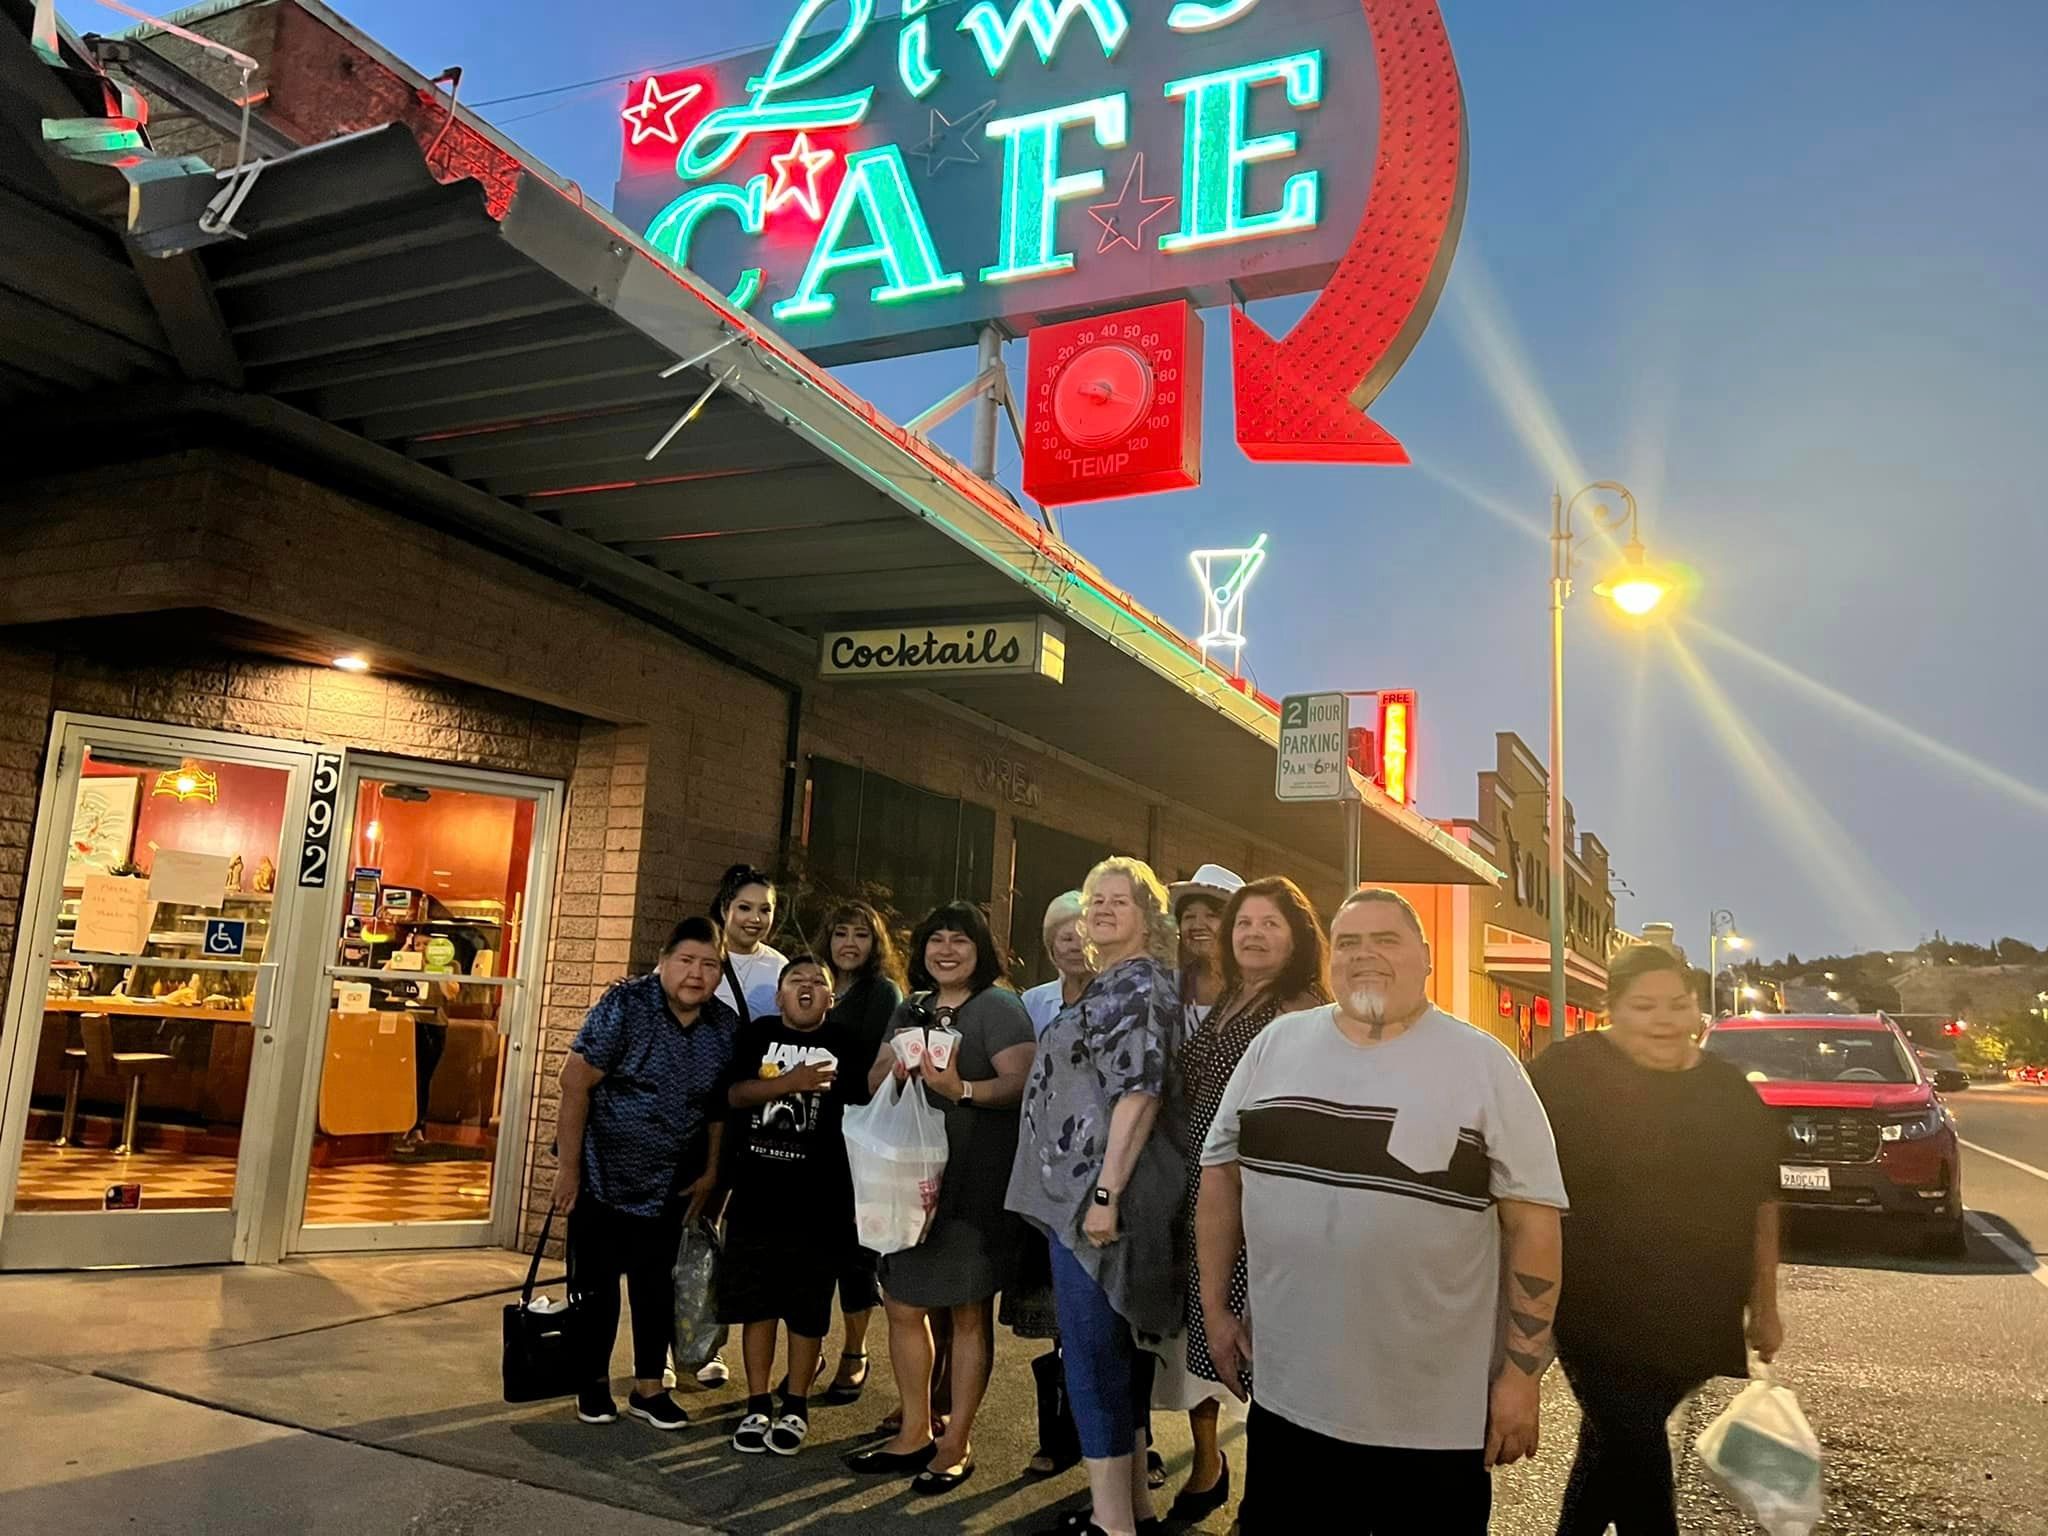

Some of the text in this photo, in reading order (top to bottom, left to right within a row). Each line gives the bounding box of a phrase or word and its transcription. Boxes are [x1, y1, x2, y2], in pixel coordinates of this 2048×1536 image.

[676, 0, 1262, 180] Lim
[643, 48, 1322, 320] CAFE
[1101, 324, 1118, 337] 40
[1124, 325, 1141, 338] 50
[1078, 332, 1094, 345] 30
[1141, 334, 1159, 347] 60
[1058, 346, 1074, 360] 20
[1156, 349, 1172, 361] 70
[1159, 368, 1177, 381] 80
[1158, 392, 1176, 405] 90
[1034, 420, 1050, 433] 20
[1146, 415, 1169, 430] 100
[1042, 437, 1058, 450] 30
[1127, 437, 1149, 451] 120
[1055, 448, 1072, 461] 40
[1069, 453, 1130, 478] TEMP
[832, 629, 1020, 669] Cocktails
[1382, 694, 1410, 704] FREE
[1287, 702, 1340, 725] 2 HOUR
[1283, 733, 1340, 755] PARKING
[300, 755, 340, 886] 592
[762, 1042, 822, 1074] JAW
